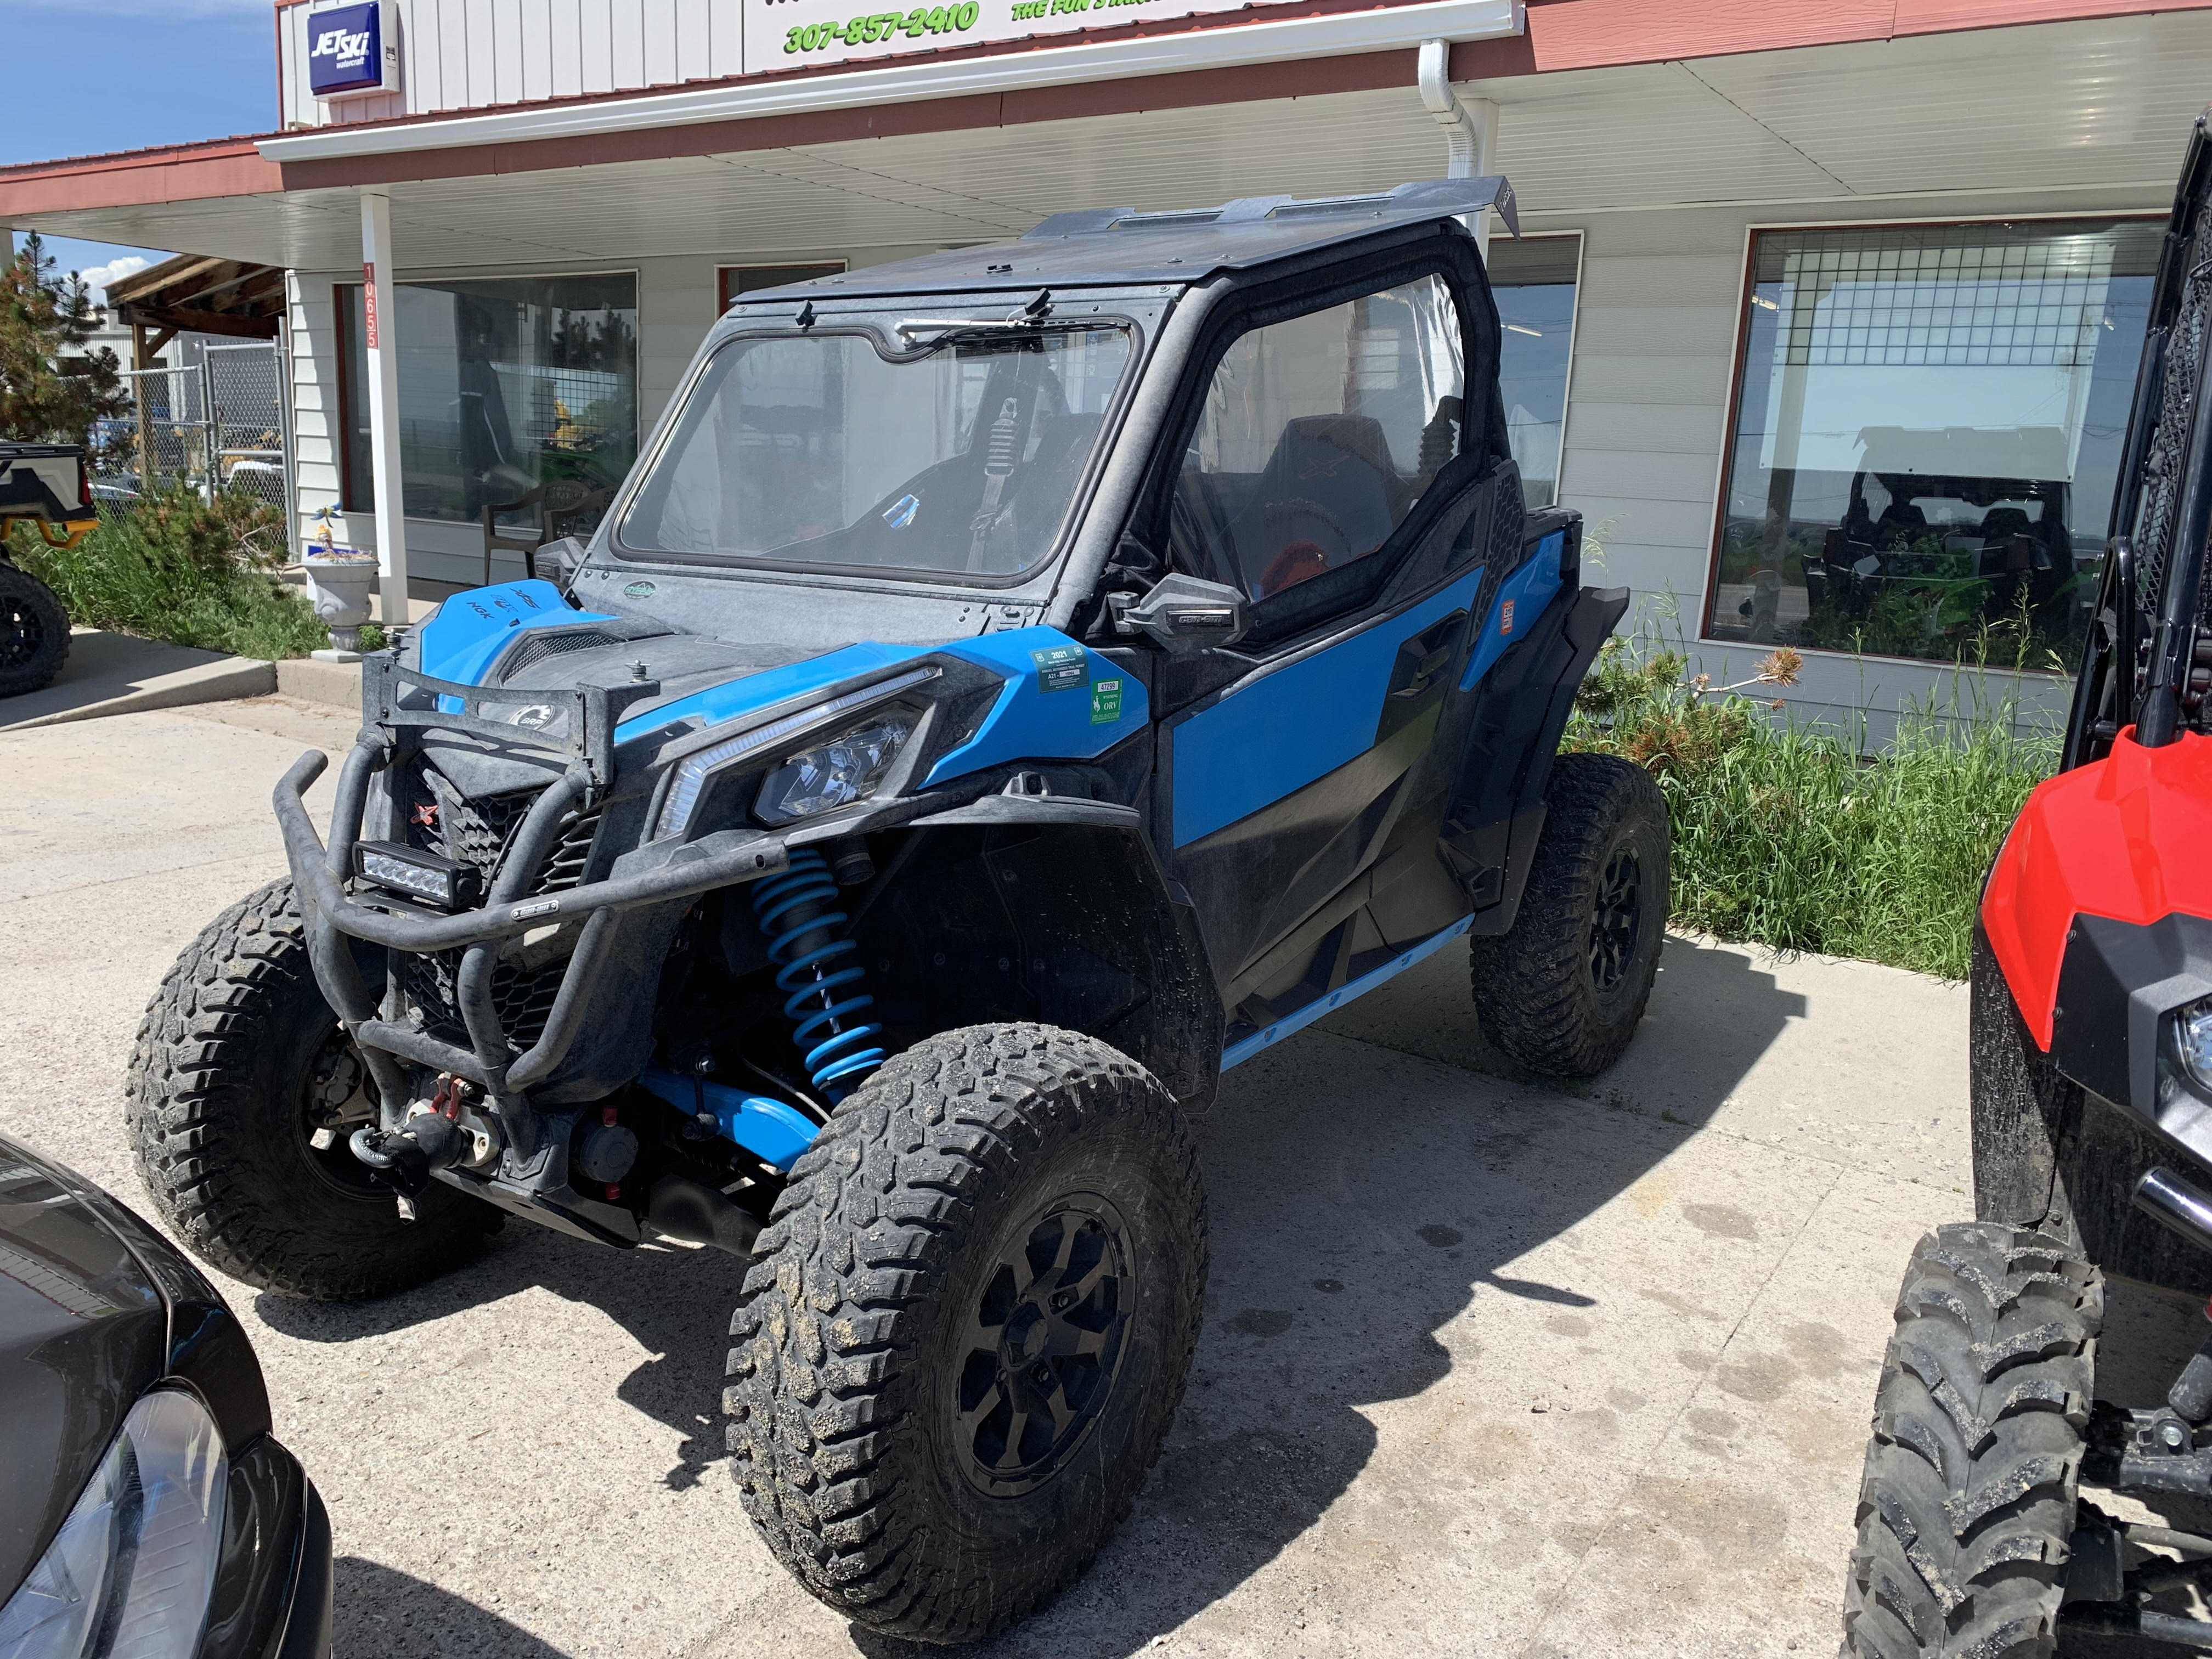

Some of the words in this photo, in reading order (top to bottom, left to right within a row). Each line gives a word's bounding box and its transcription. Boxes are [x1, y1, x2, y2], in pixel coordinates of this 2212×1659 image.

[1011, 1, 1047, 21] THE
[1051, 0, 1089, 16] FUN
[783, 1, 979, 54] 307-857-2410
[336, 57, 365, 69] watercraft
[366, 264, 375, 347] 10655
[466, 601, 495, 619] NGK
[1178, 615, 1223, 624] can-am
[1051, 650, 1068, 659] 2021
[1101, 682, 1115, 691] 47299
[1104, 701, 1118, 710] ORV
